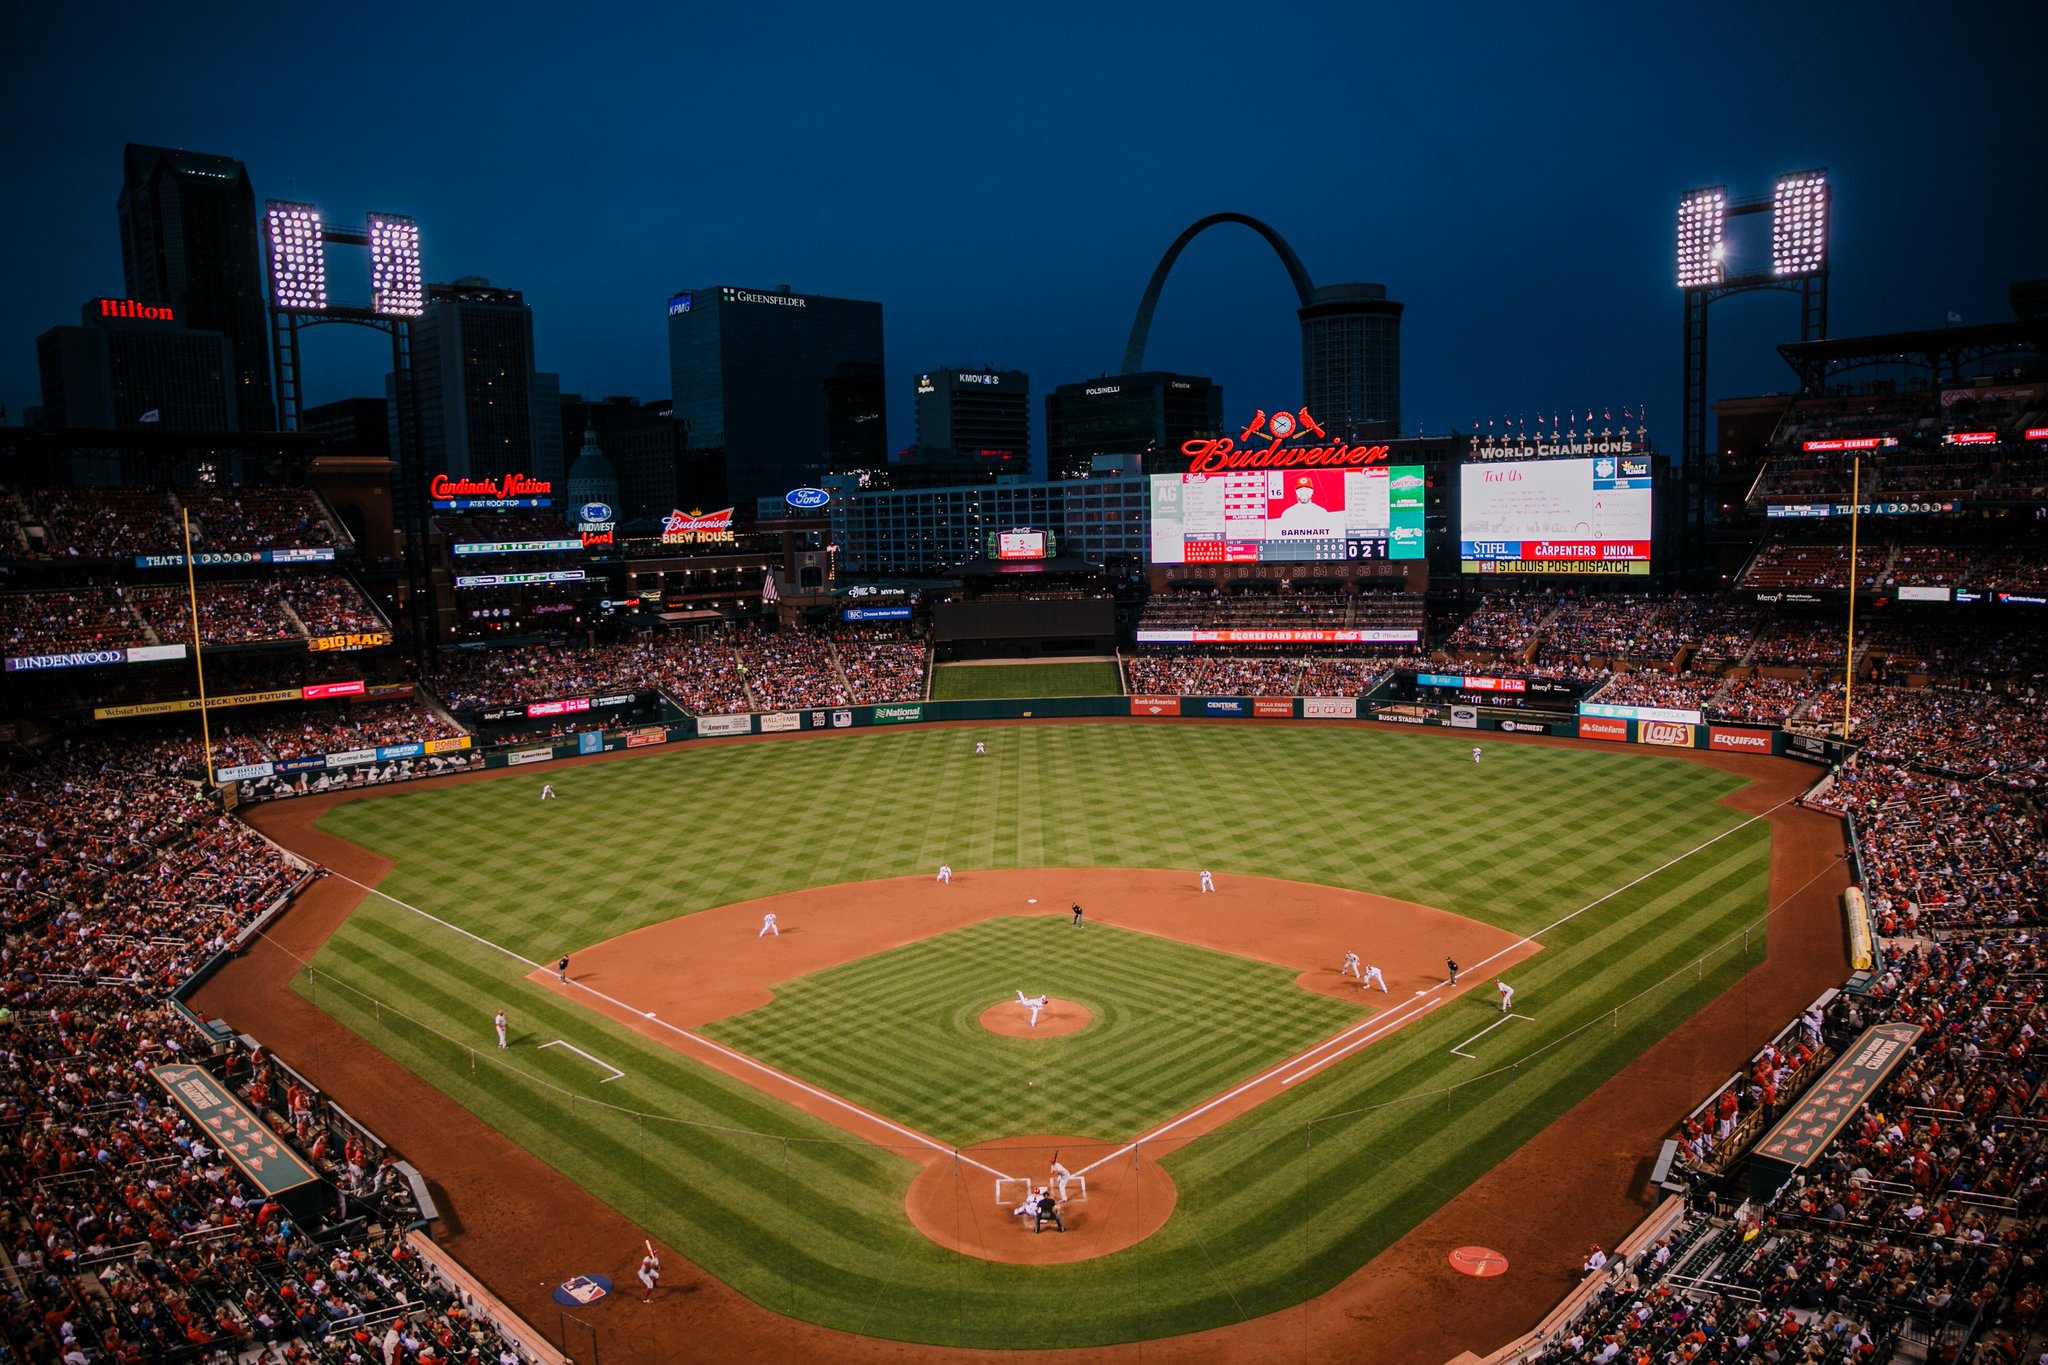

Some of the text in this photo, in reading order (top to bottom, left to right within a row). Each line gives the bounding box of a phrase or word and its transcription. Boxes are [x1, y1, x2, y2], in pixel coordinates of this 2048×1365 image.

[737, 290, 806, 308] GREENSFELDER
[101, 299, 174, 321] Hilton
[668, 302, 691, 316] KPMG
[959, 374, 982, 384] KMOV
[1086, 385, 1120, 396] POLSINELLI
[1181, 437, 1390, 473] Budweiser
[1480, 441, 1632, 459] WORLD CHAMPIONS
[431, 473, 551, 500] Cardinals Nation
[795, 490, 821, 505] Ford
[1157, 486, 1178, 502] AG
[578, 522, 616, 532] MIDWEST
[661, 516, 734, 532] Budweiser
[662, 530, 735, 545] BREW HOUSE
[1281, 528, 1330, 537] BARNHART
[581, 531, 613, 548] Live!
[1348, 546, 1358, 558] 0
[1362, 545, 1372, 557] 2
[1377, 545, 1385, 557] 1
[1473, 541, 1509, 554] STIFEL
[1535, 545, 1634, 556] CARPENTERS UNION
[146, 555, 183, 566] THAT'S
[1499, 561, 1630, 572] ST. LOUIS POST-DISPATCH
[1757, 593, 1779, 602] Mercy
[318, 633, 384, 651] BIG MAC
[1230, 632, 1324, 640] SCOREBOARD PATIO
[14, 651, 122, 670] LINDENWOOD
[1531, 684, 1548, 692] Mercy
[104, 708, 134, 717] Webster
[135, 704, 173, 715] University
[204, 697, 232, 707] DECK:
[233, 695, 258, 703] YOUR
[259, 692, 296, 701] FUTURE.
[885, 707, 920, 717] National
[1378, 714, 1424, 724] BUSCH STADIUM
[707, 723, 730, 731] Ameren
[1516, 723, 1544, 731] MIDWEST
[1645, 722, 1686, 744] Lay's
[434, 739, 462, 749] DOBBS
[1713, 734, 1766, 746] EQUIFAX
[336, 753, 360, 763] Central
[361, 752, 376, 760] Bank
[521, 751, 551, 759] Ameritrade
